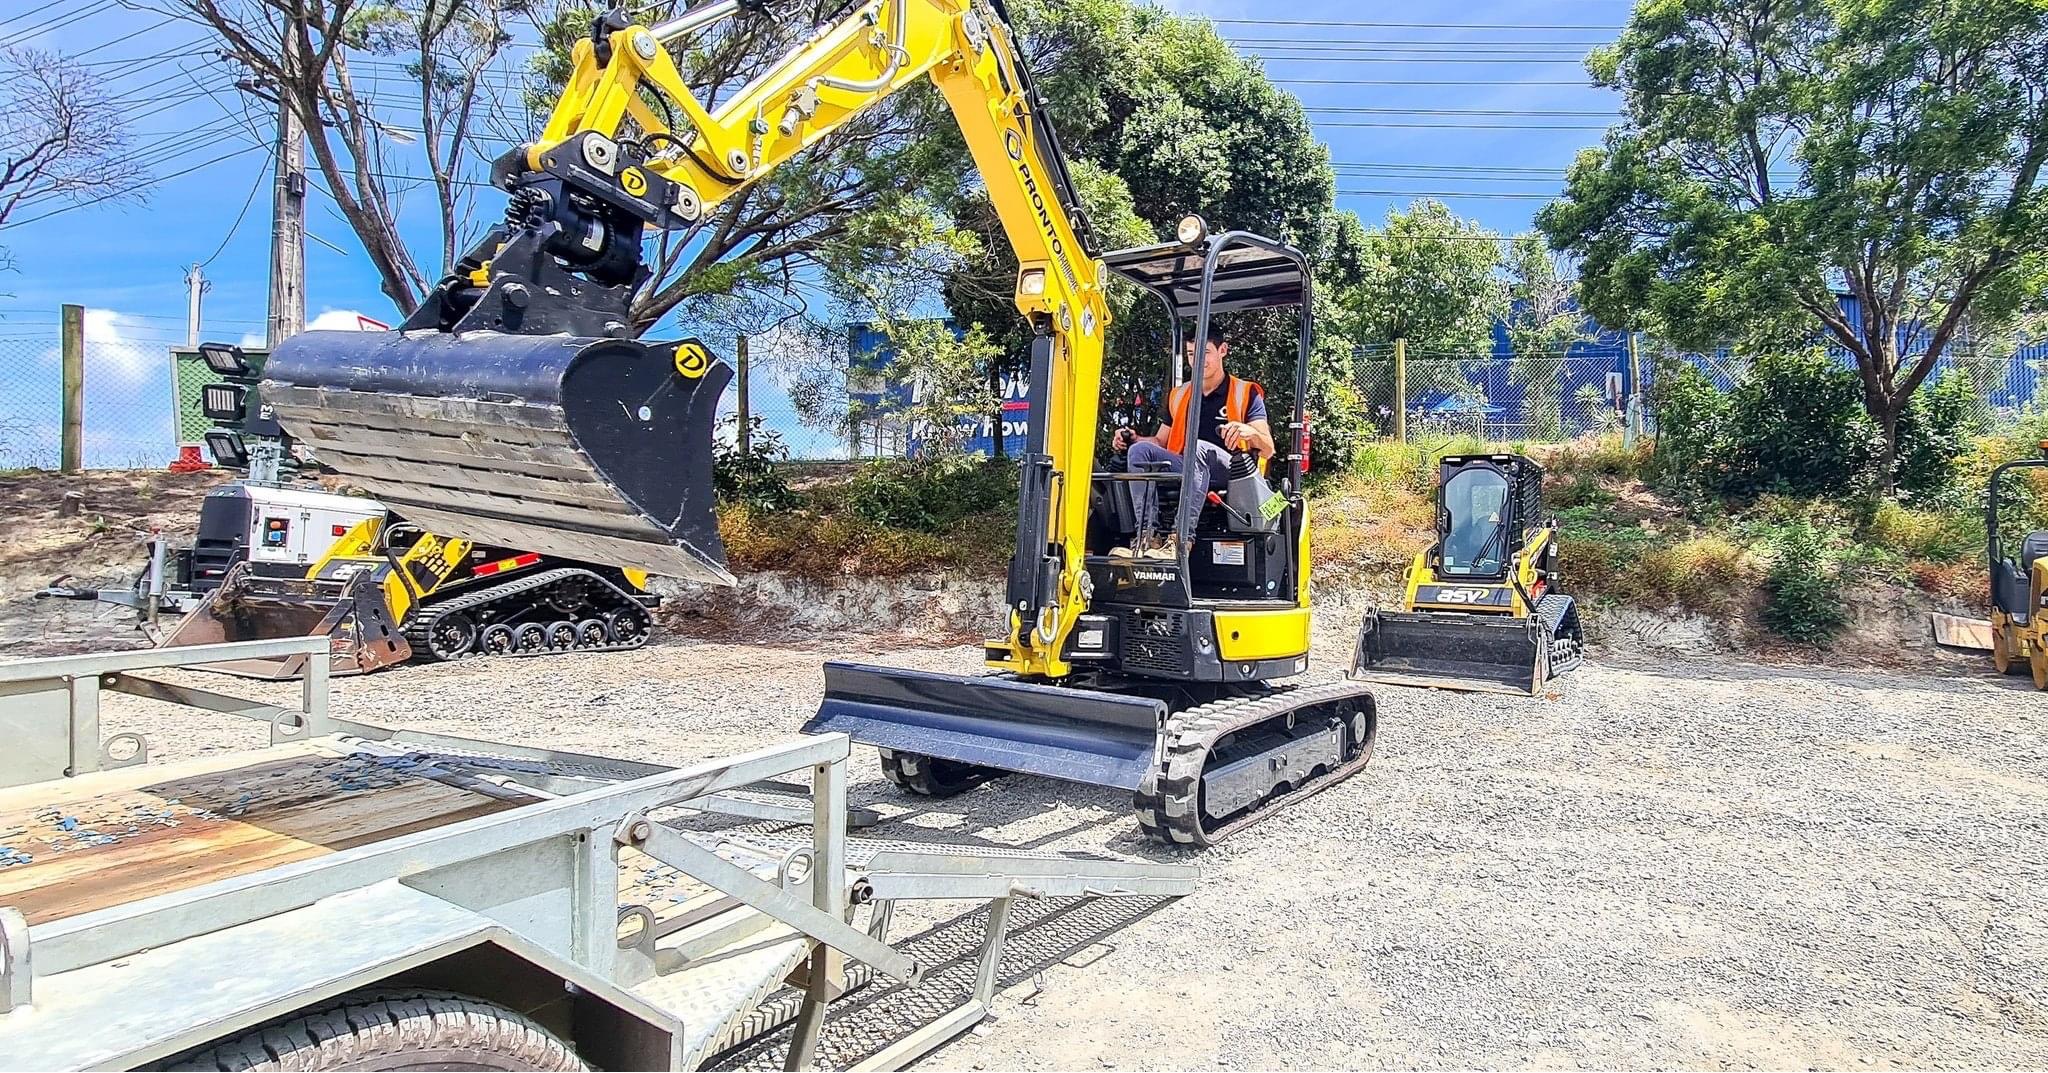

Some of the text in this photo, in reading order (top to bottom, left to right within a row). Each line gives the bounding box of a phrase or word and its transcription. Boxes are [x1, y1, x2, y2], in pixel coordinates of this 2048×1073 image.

[1018, 163, 1063, 255] PRONTO
[911, 419, 978, 440] Kow
[1133, 570, 1176, 581] YANMAR
